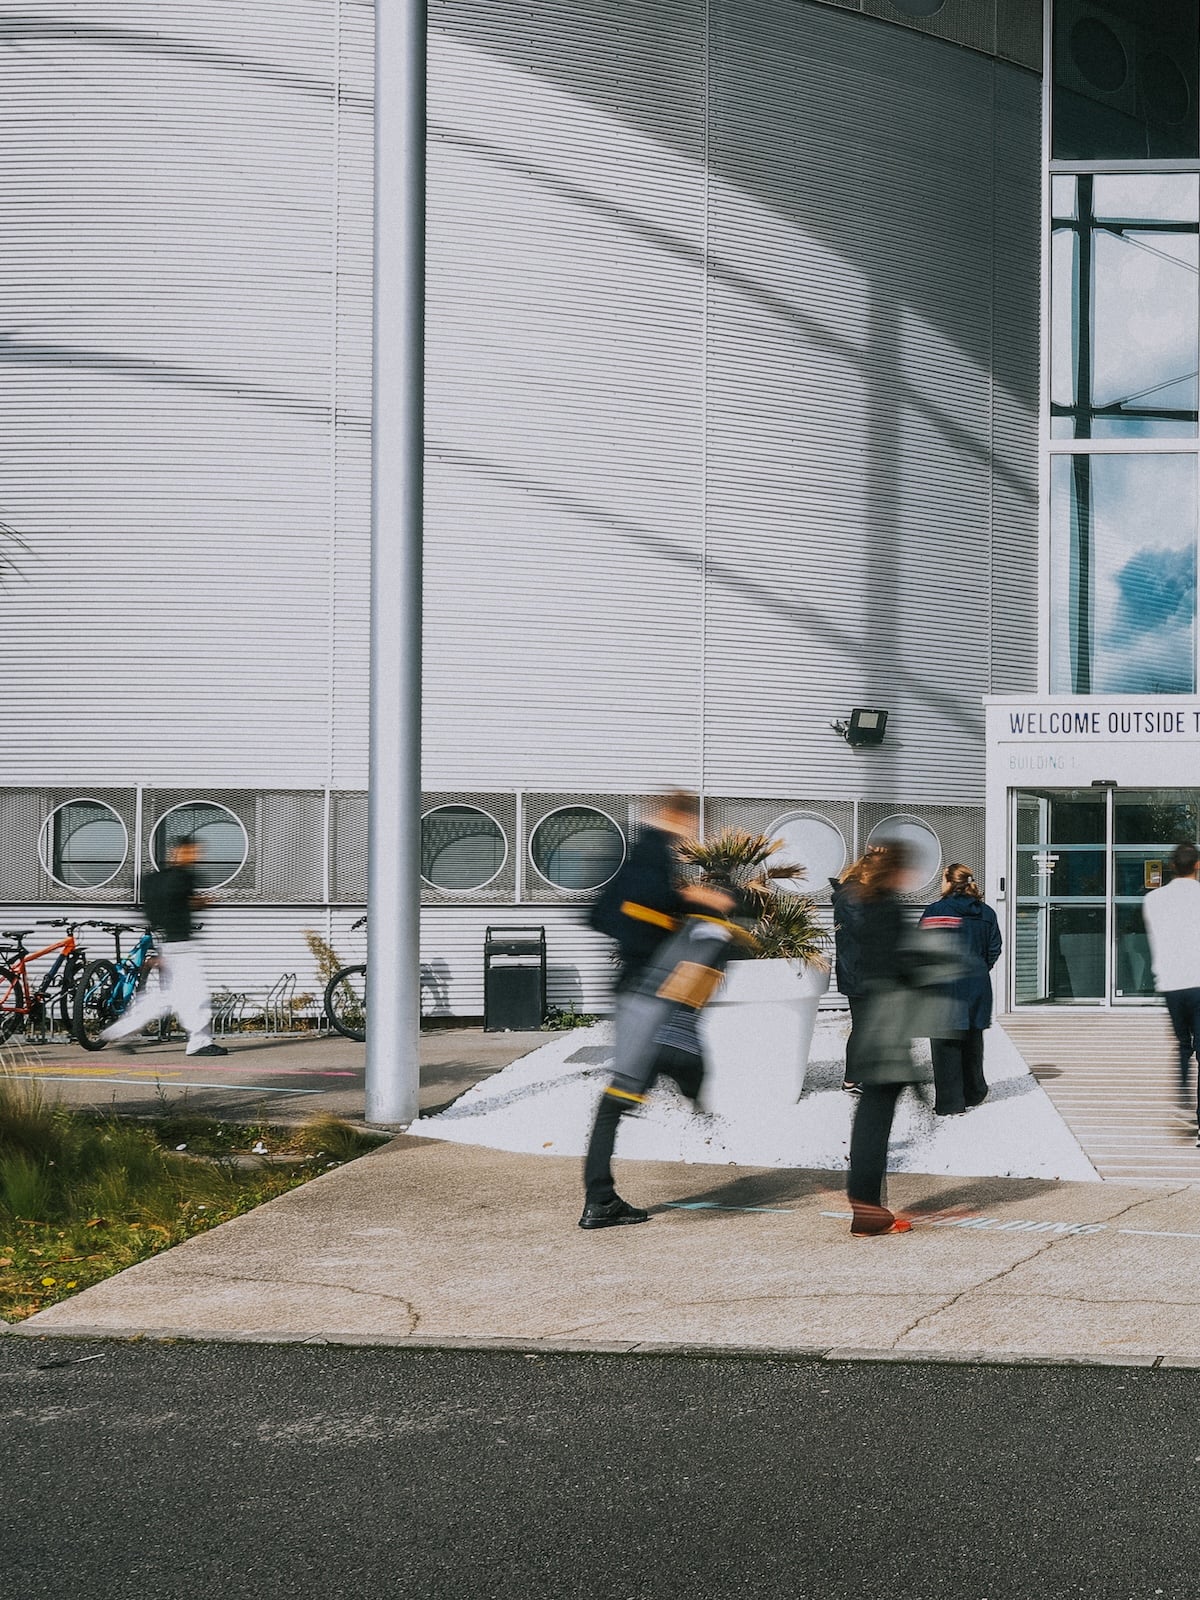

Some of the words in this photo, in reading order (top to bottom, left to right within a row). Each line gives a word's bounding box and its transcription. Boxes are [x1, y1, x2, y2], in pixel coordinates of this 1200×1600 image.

[1009, 712, 1101, 734] WELCOME
[1108, 711, 1186, 734] OUTSIDE
[1009, 755, 1065, 769] BUILDING
